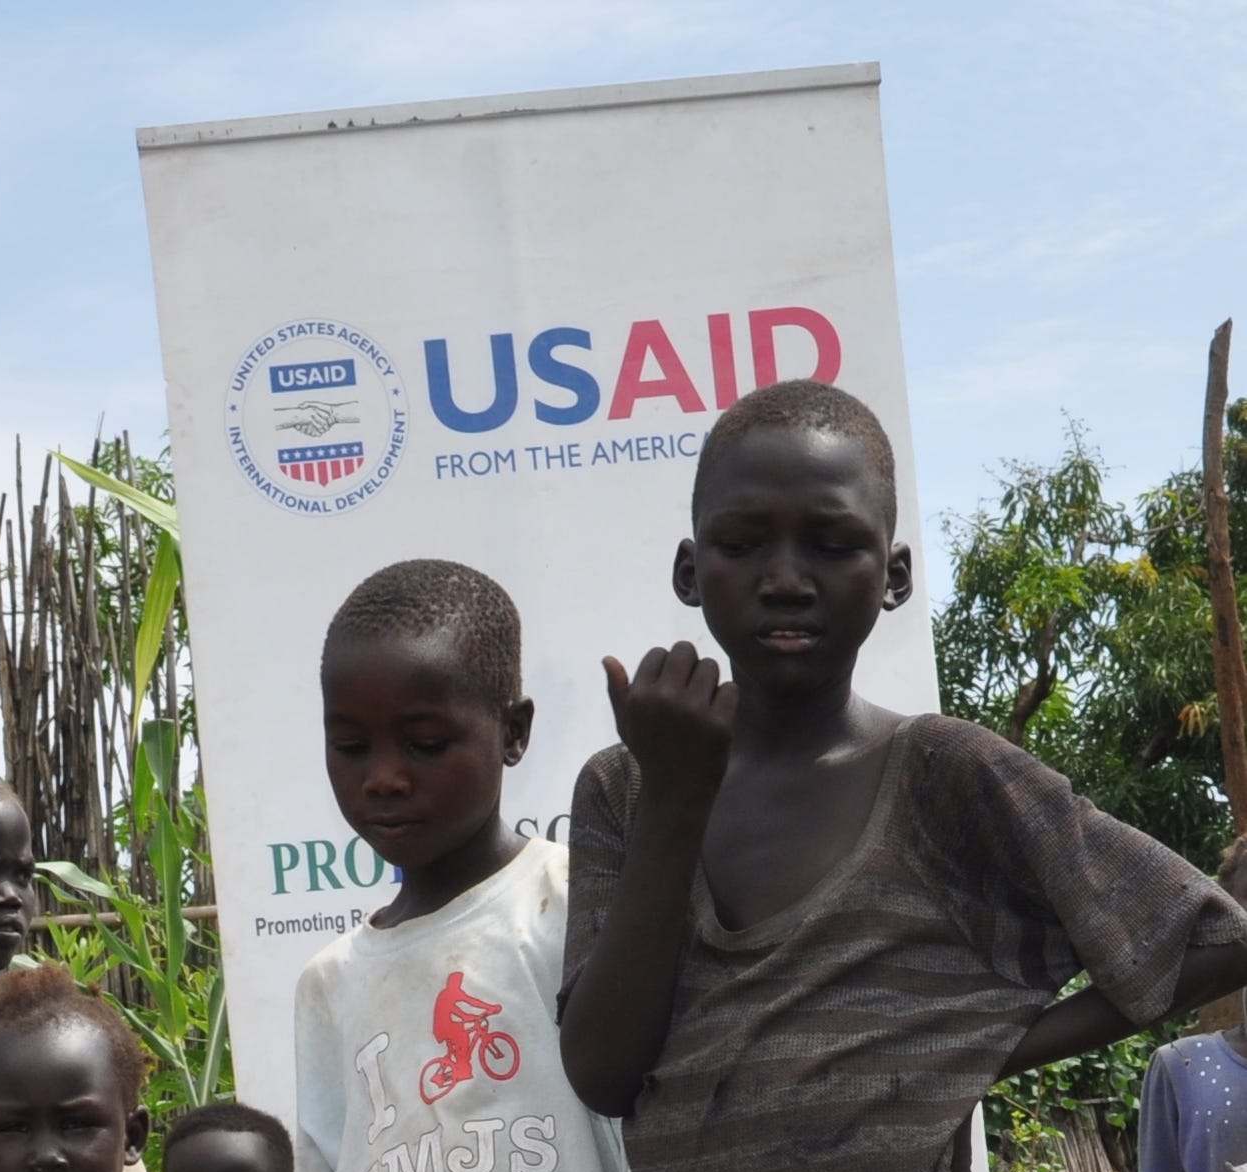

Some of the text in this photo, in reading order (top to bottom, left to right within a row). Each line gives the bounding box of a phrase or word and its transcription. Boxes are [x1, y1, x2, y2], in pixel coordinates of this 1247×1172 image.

[232, 322, 395, 391] UNITED STATES AGENCY
[277, 364, 346, 387] USAID
[423, 306, 841, 434] USAID
[229, 409, 406, 513] INTERNATIONAL DEVELOPMENT
[435, 432, 709, 479] FROM THE AMERIC
[266, 835, 404, 895] PRO
[255, 912, 345, 936] Promoting
